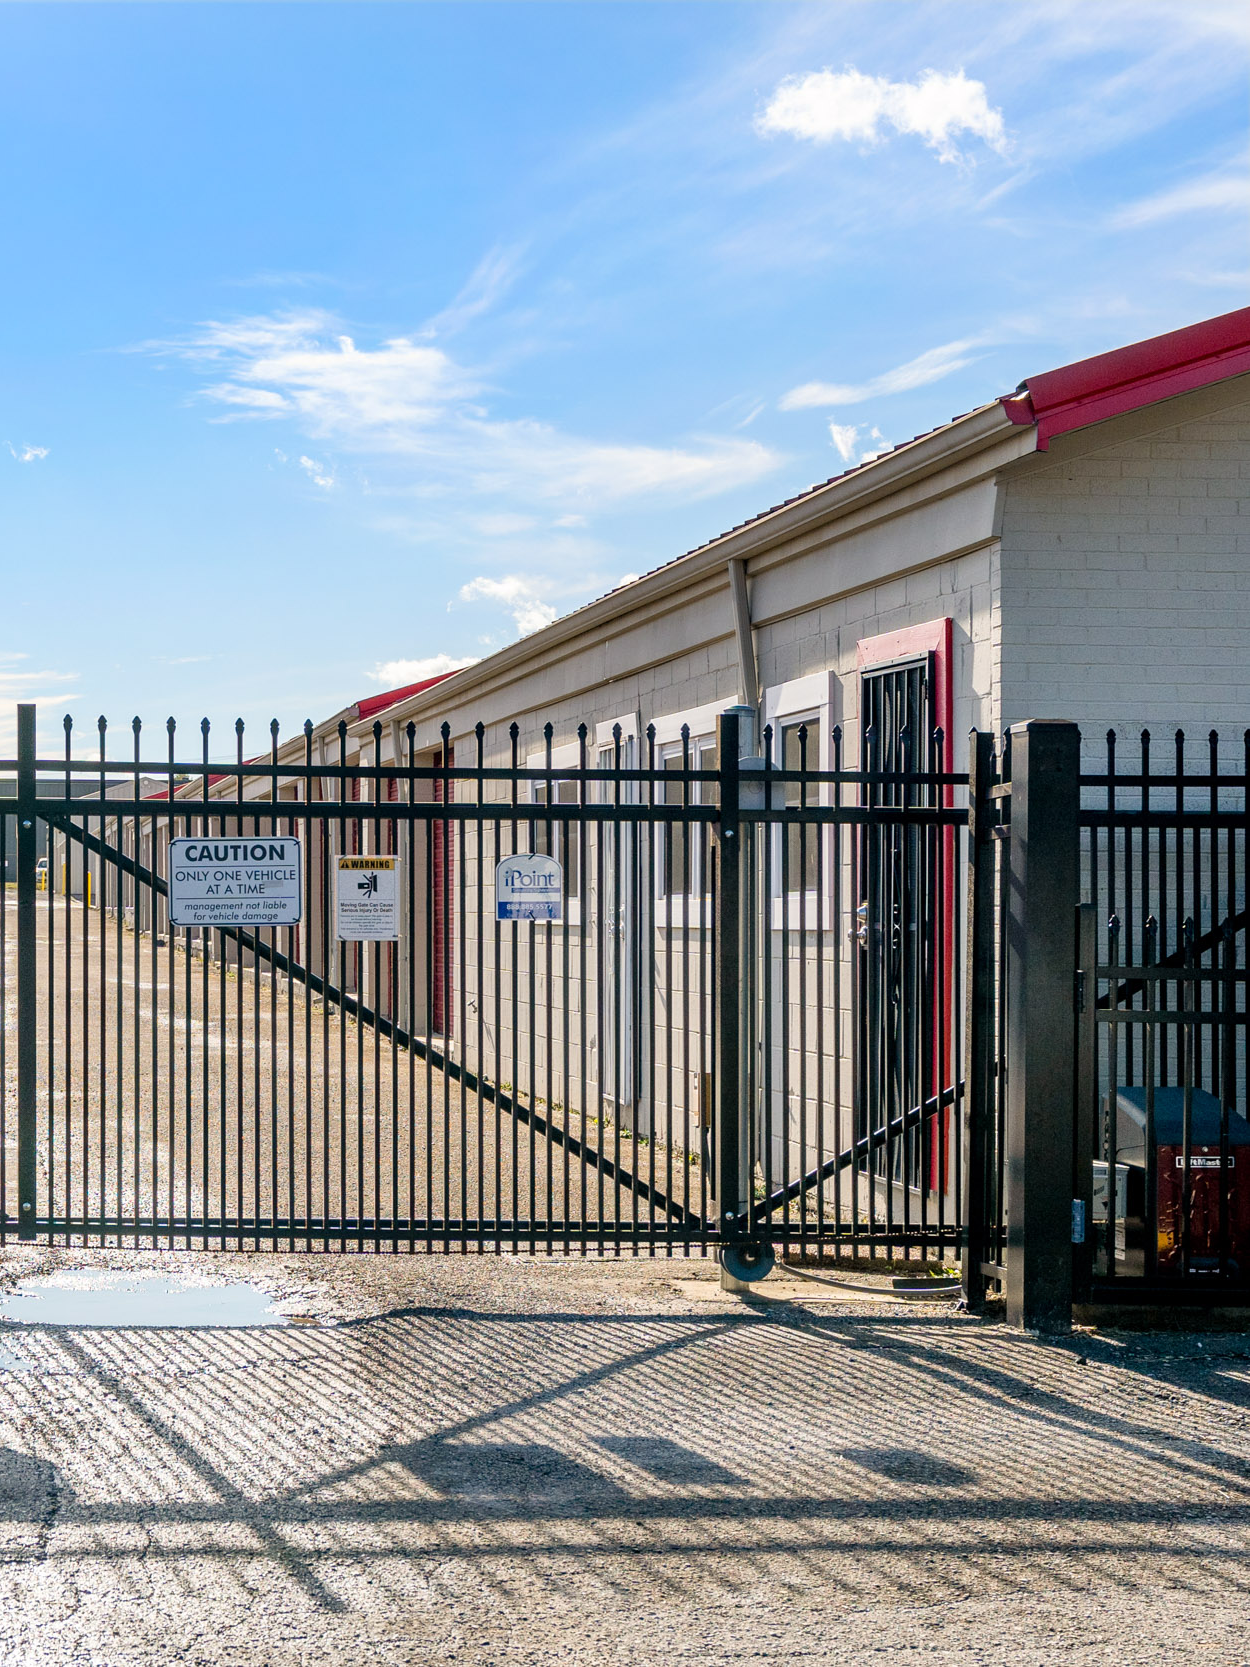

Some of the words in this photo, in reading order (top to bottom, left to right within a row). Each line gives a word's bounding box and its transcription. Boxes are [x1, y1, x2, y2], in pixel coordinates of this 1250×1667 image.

[185, 844, 285, 862] CAUTION
[351, 860, 390, 869] WARNING
[175, 870, 210, 882] ONLY
[213, 870, 242, 881] ONE
[245, 869, 296, 881] VEHICLE
[505, 870, 555, 887] iPoint
[206, 884, 221, 895] AT
[224, 884, 234, 895] A
[236, 883, 266, 895] TIME
[184, 902, 243, 912] management
[245, 902, 260, 910] not
[262, 901, 287, 910] liable
[193, 912, 207, 921] for
[208, 912, 239, 920] vehicle
[240, 911, 279, 921] damage
